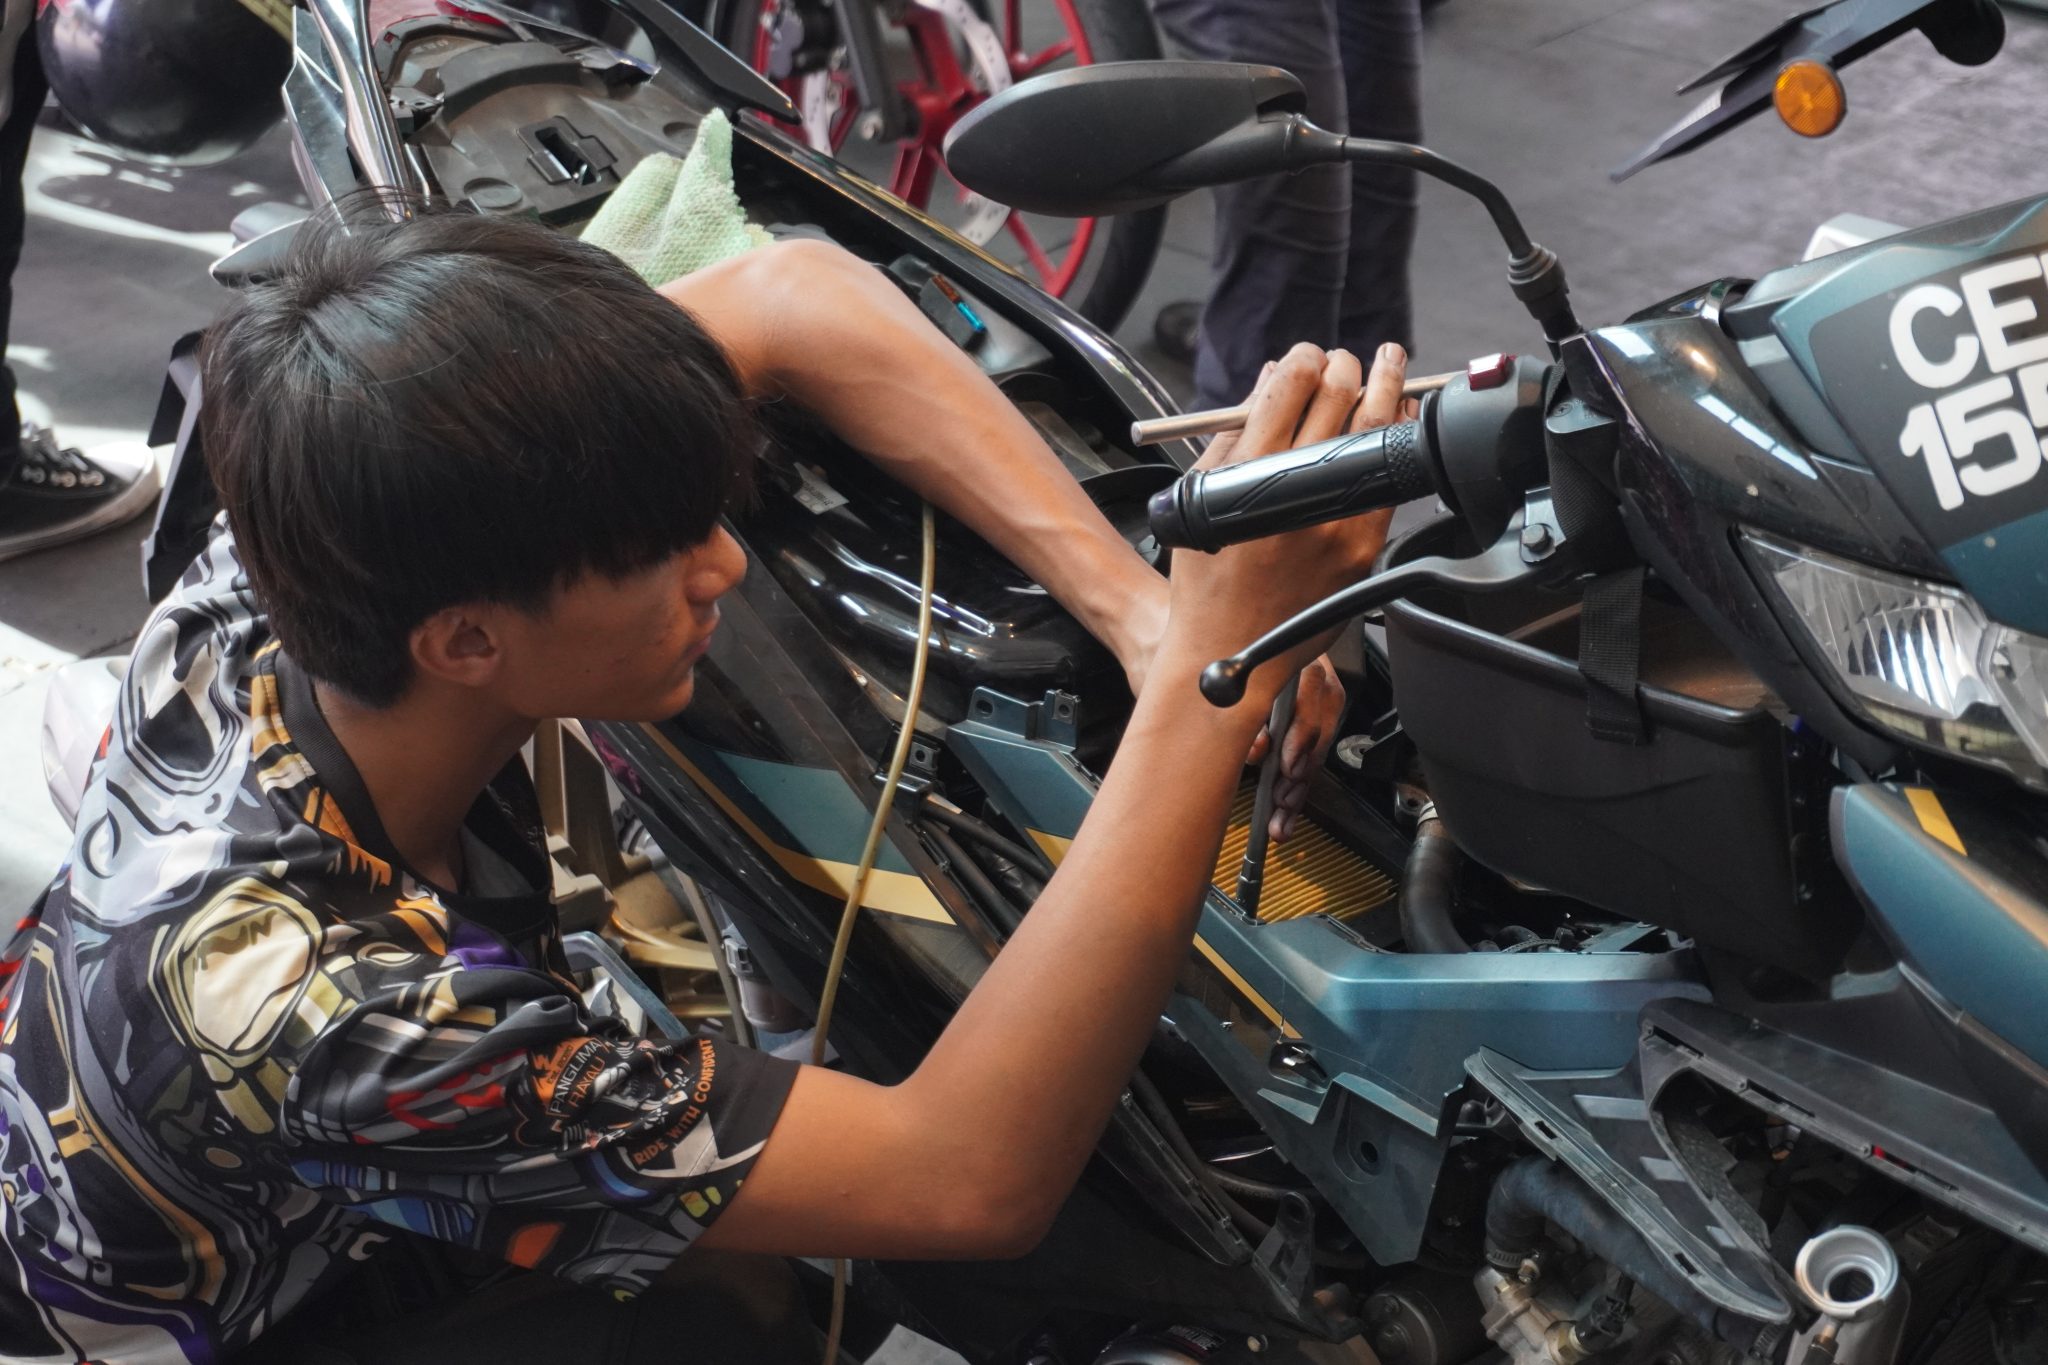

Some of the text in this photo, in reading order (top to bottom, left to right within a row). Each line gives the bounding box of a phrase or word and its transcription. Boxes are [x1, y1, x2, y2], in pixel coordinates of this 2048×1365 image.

[1889, 252, 2048, 389] CE
[550, 1040, 601, 1114] PANGLIMA
[633, 1038, 716, 1166] RIDE WITH CONFIDENT
